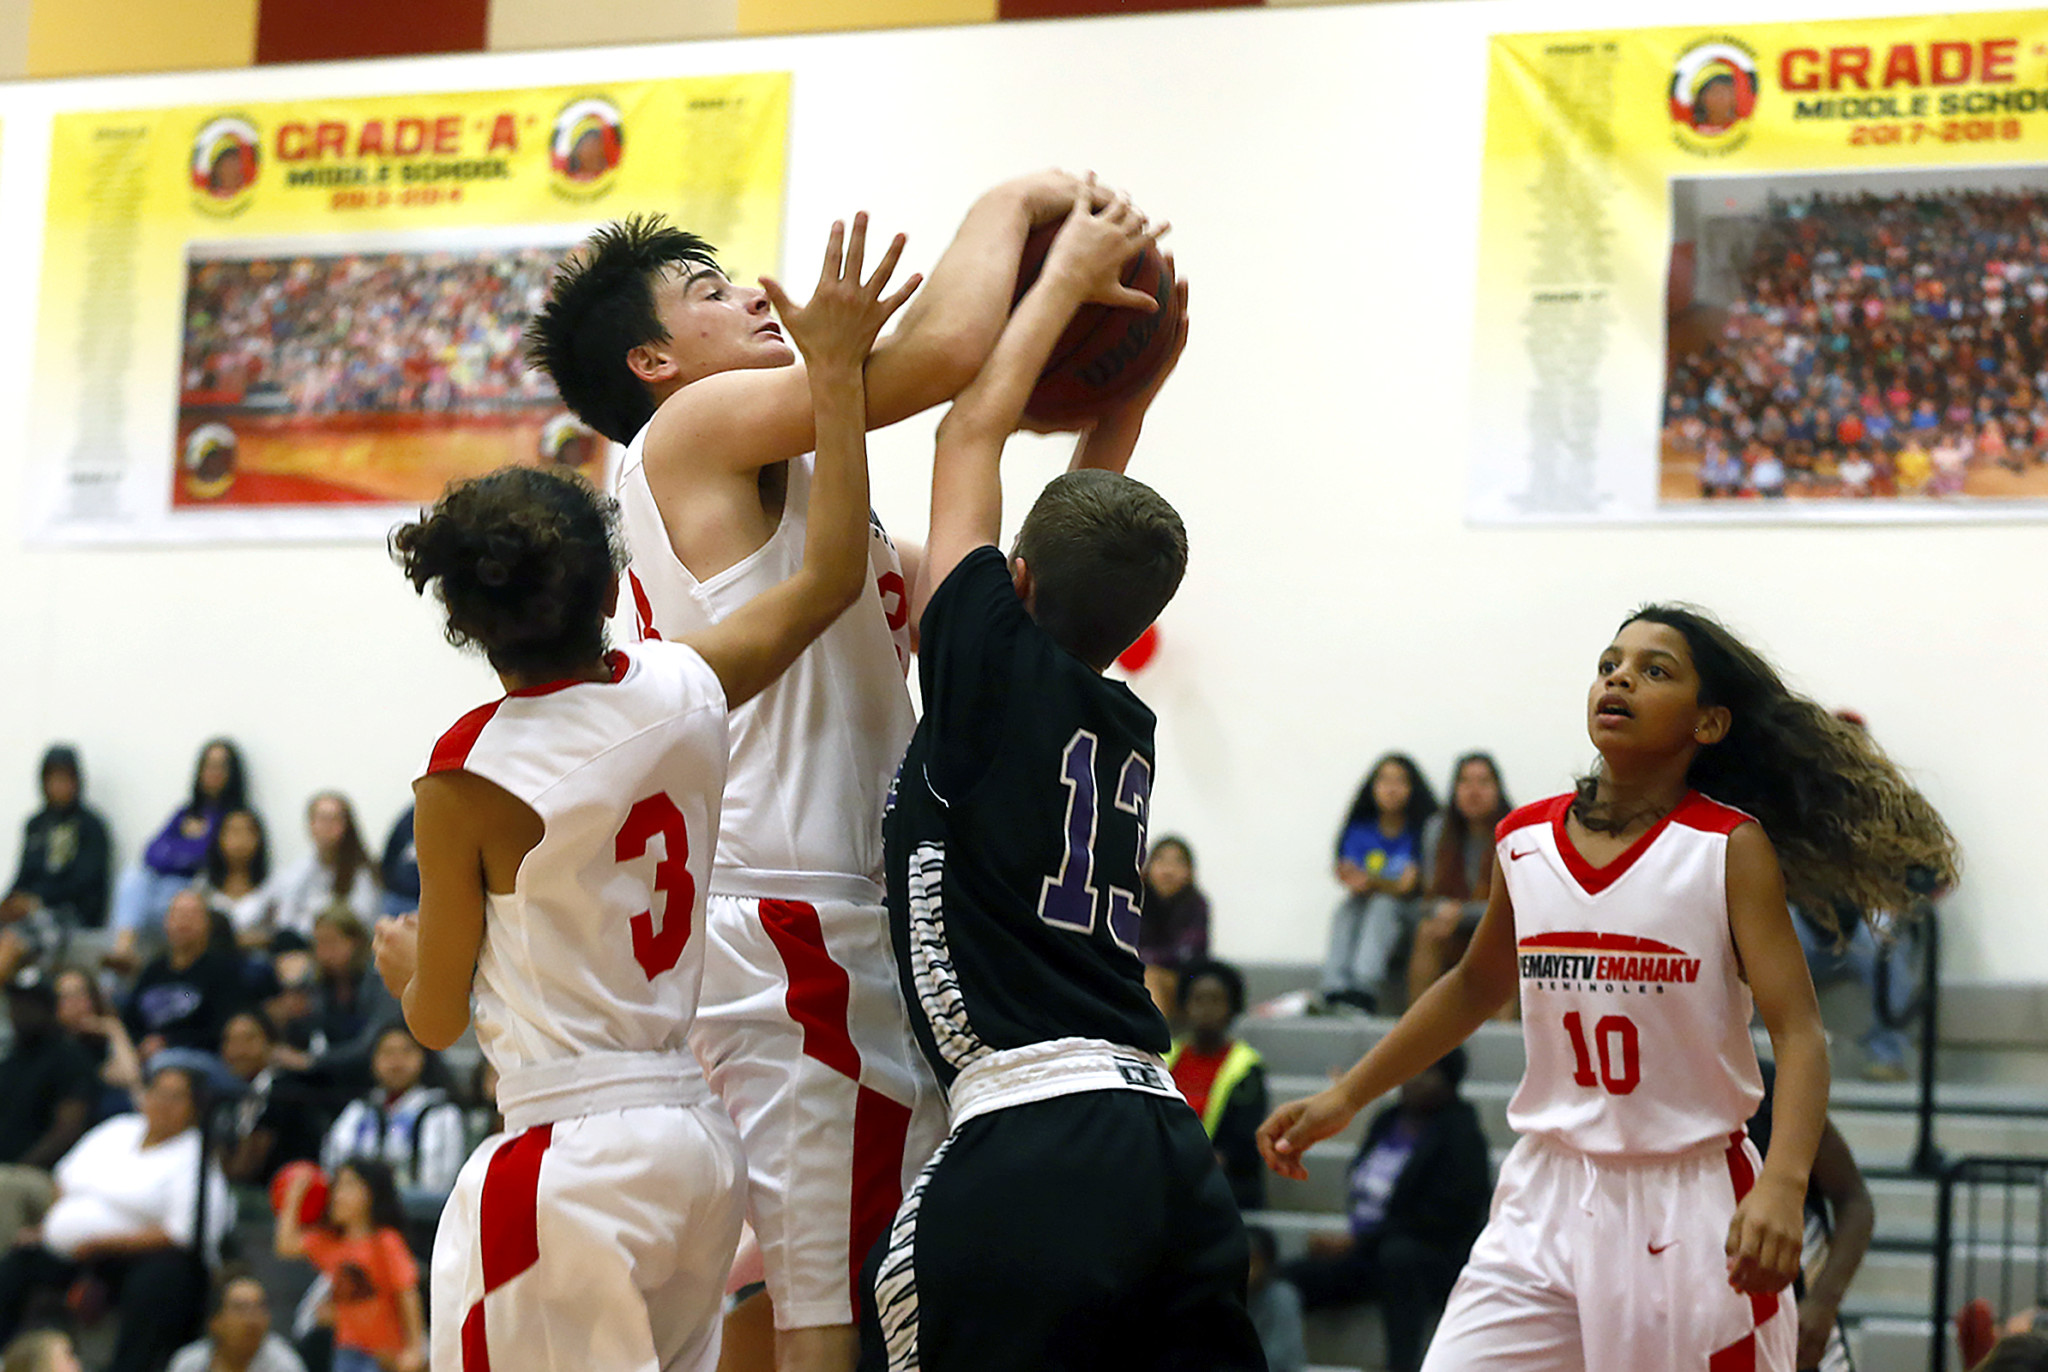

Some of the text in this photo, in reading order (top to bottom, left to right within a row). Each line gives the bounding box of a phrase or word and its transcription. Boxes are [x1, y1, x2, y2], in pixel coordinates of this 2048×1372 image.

[1778, 38, 2018, 91] GRADE
[1793, 95, 1930, 120] MIDDLE
[276, 115, 463, 162] GRADE
[614, 791, 696, 982] 3
[1537, 981, 1665, 995] SEMINOLES
[1596, 956, 1701, 983] EMAHAKV
[1562, 1010, 1641, 1096] 10
